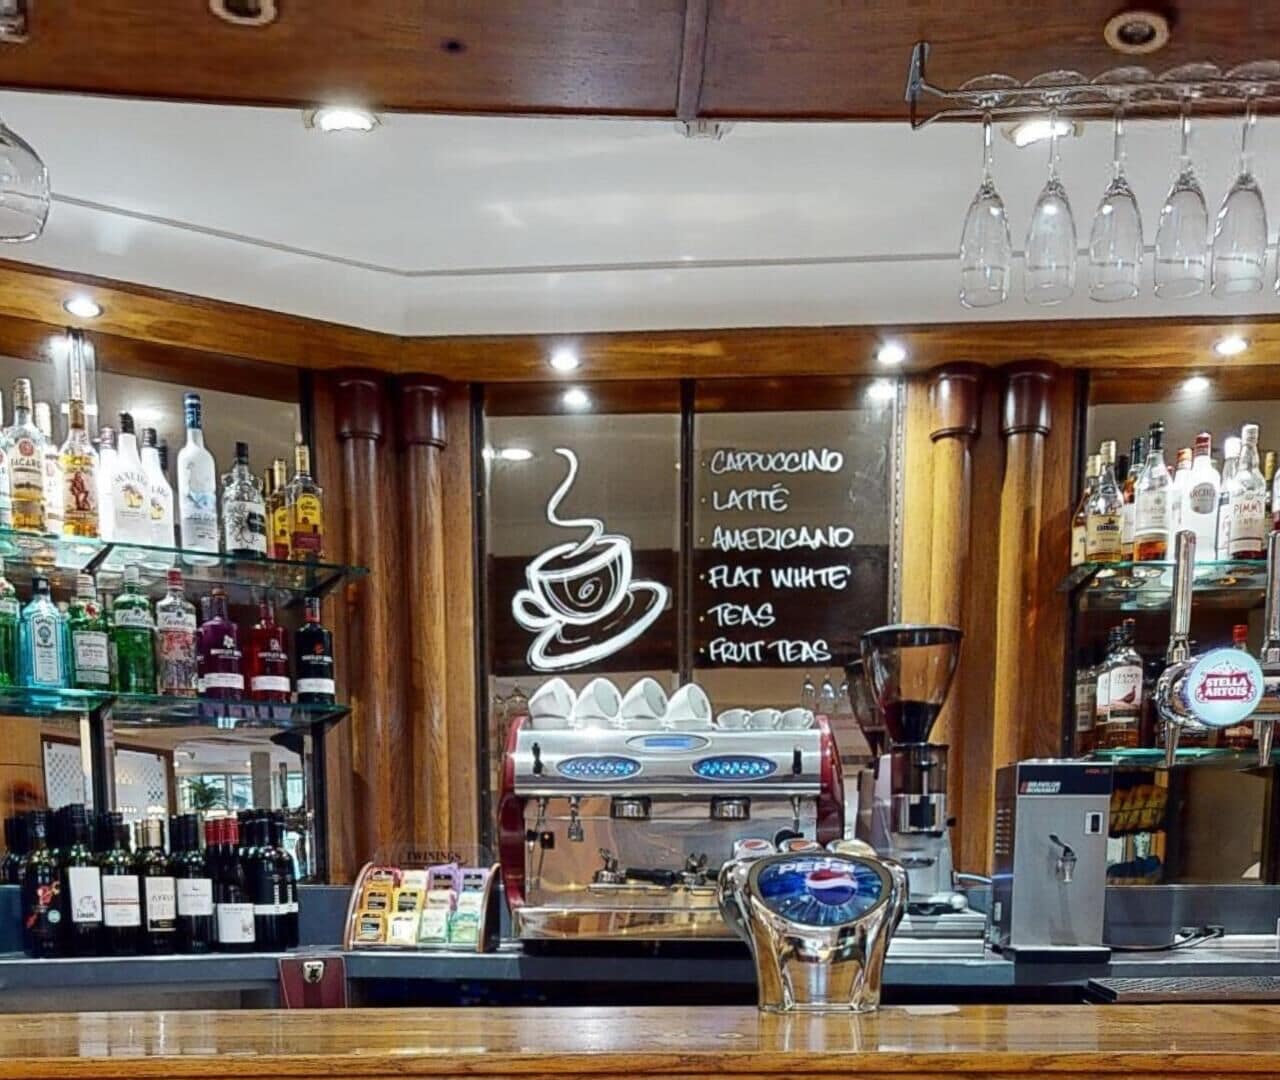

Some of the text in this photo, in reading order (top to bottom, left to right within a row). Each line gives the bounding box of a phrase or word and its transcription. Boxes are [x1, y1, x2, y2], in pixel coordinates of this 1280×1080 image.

[711, 449, 844, 474] CAPPUCCINO
[713, 482, 790, 512] LATTÉ
[712, 526, 854, 551] AMERICANO
[709, 565, 851, 589] FLAT WHITE
[707, 602, 776, 628] TEAS
[709, 637, 832, 663] FRUIT TEAS
[1205, 686, 1248, 697] ARTOIS
[1206, 677, 1248, 687] STELLA
[778, 860, 856, 875] PEPSI
